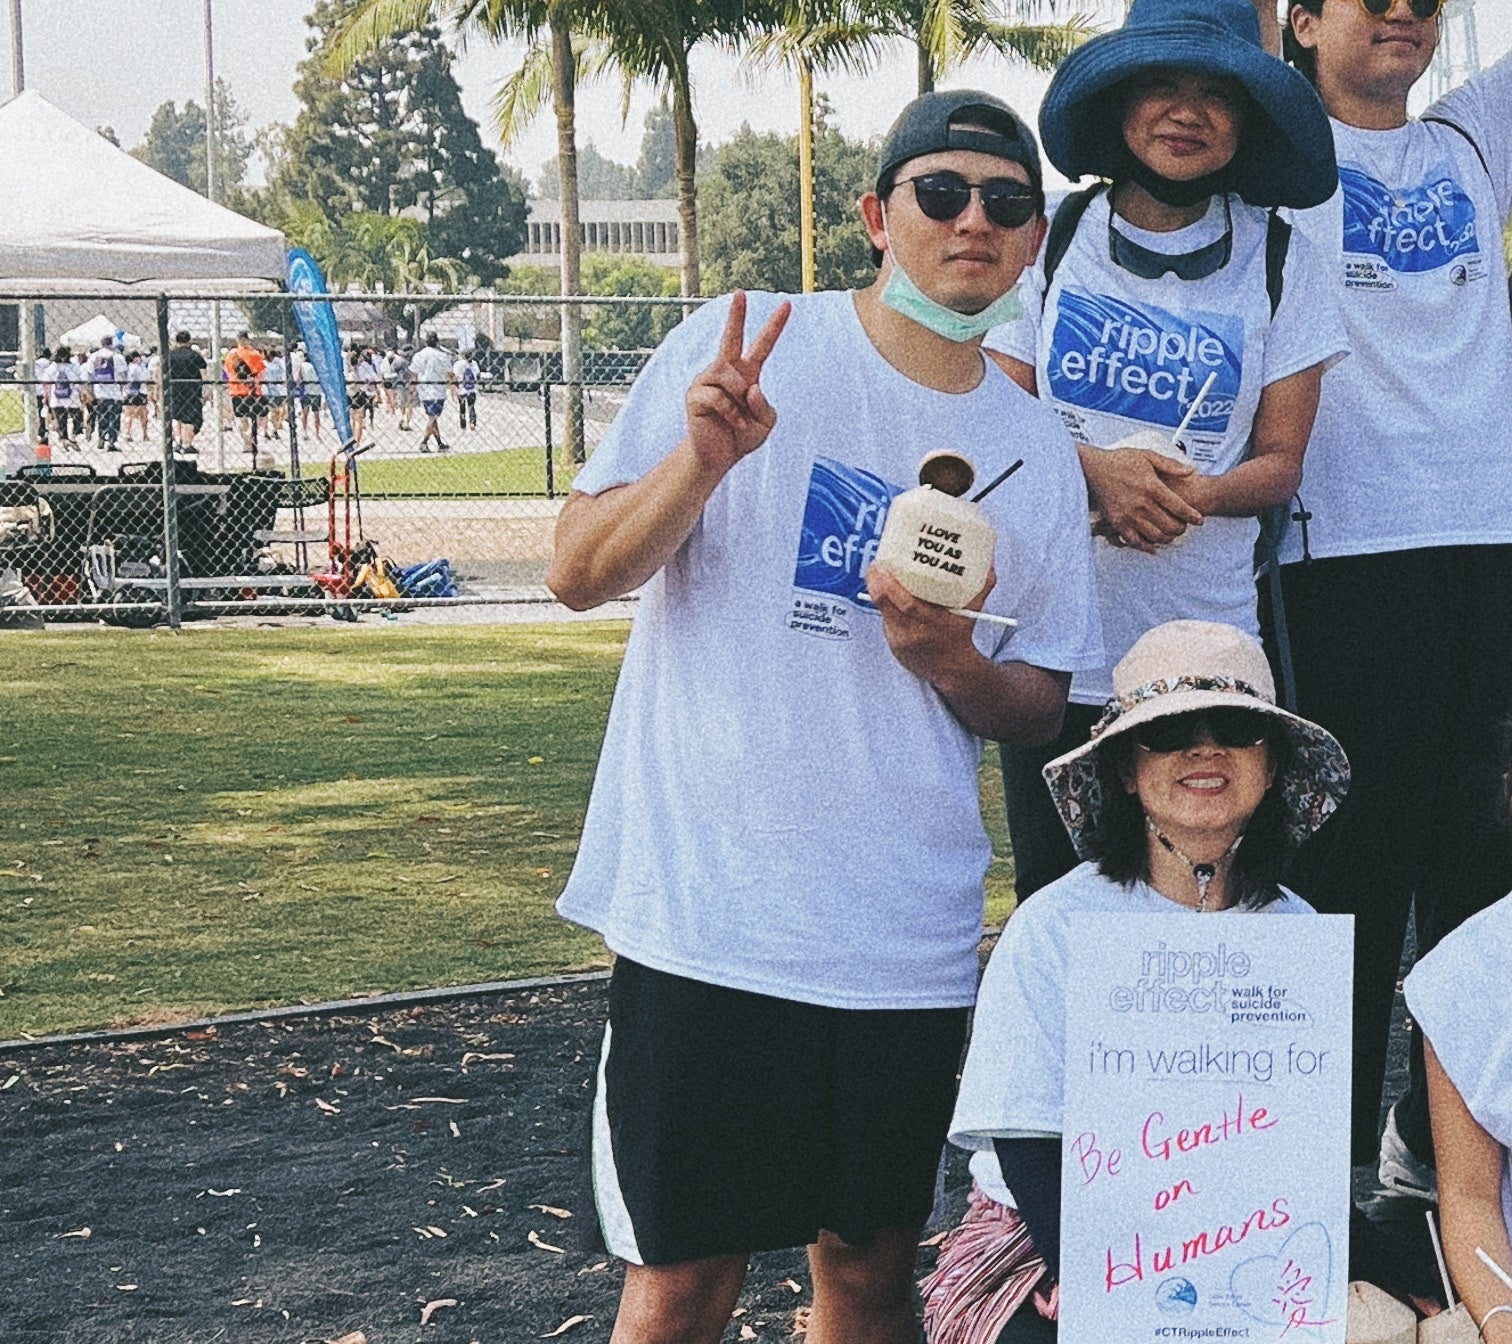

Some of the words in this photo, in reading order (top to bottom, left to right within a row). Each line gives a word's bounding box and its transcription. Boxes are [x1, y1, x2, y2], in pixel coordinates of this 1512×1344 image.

[1367, 214, 1451, 253] ffect
[1100, 315, 1225, 367] ripple
[1061, 346, 1194, 404] effect
[917, 537, 944, 553] YOU
[945, 546, 963, 560] AS
[927, 524, 962, 544] LOVE
[821, 534, 881, 579] eff
[912, 550, 938, 568] YOU
[939, 560, 966, 577] ARE
[832, 604, 848, 616] for
[790, 620, 850, 637] prevention
[1141, 942, 1251, 984] ripple
[1109, 977, 1228, 1014] effect
[1231, 985, 1263, 998] walk
[1268, 985, 1288, 998] for
[1231, 998, 1282, 1010] suicide
[1231, 1010, 1306, 1024] prevention
[1089, 1041, 1135, 1074] i'm
[1147, 1041, 1274, 1082] walking
[1287, 1041, 1330, 1075] for
[1070, 1131, 1122, 1186] Be
[1141, 1092, 1279, 1161] Gentle
[1154, 1179, 1201, 1211] on
[1105, 1197, 1291, 1293] Humans
[1154, 1326, 1250, 1340] #CTRippleEffect
